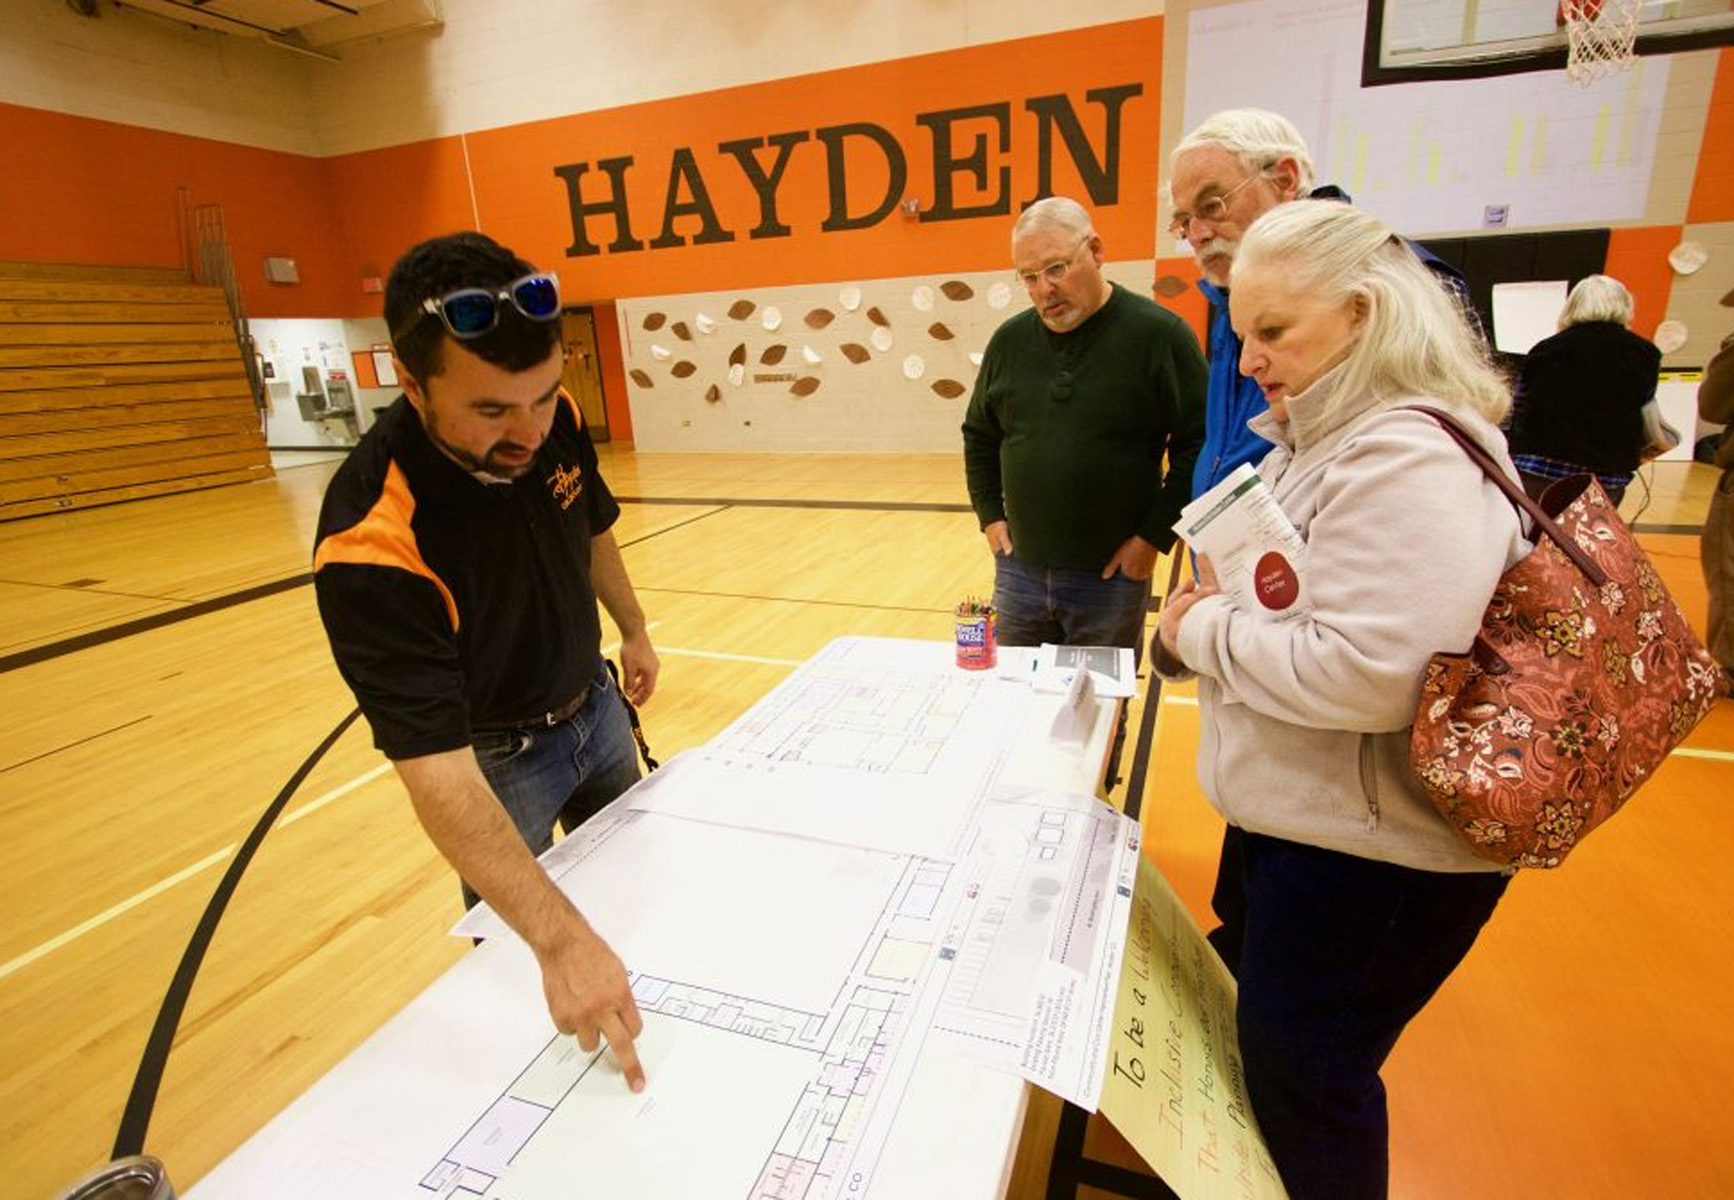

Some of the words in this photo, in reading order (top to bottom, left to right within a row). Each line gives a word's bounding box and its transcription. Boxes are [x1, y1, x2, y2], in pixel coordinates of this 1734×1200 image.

[554, 82, 1143, 258] HAYDEN
[1263, 579, 1286, 595] Center
[1132, 987, 1148, 1007] a
[1123, 1017, 1145, 1049] be
[1113, 1050, 1147, 1089] To
[1158, 1019, 1184, 1151] Inclusive
